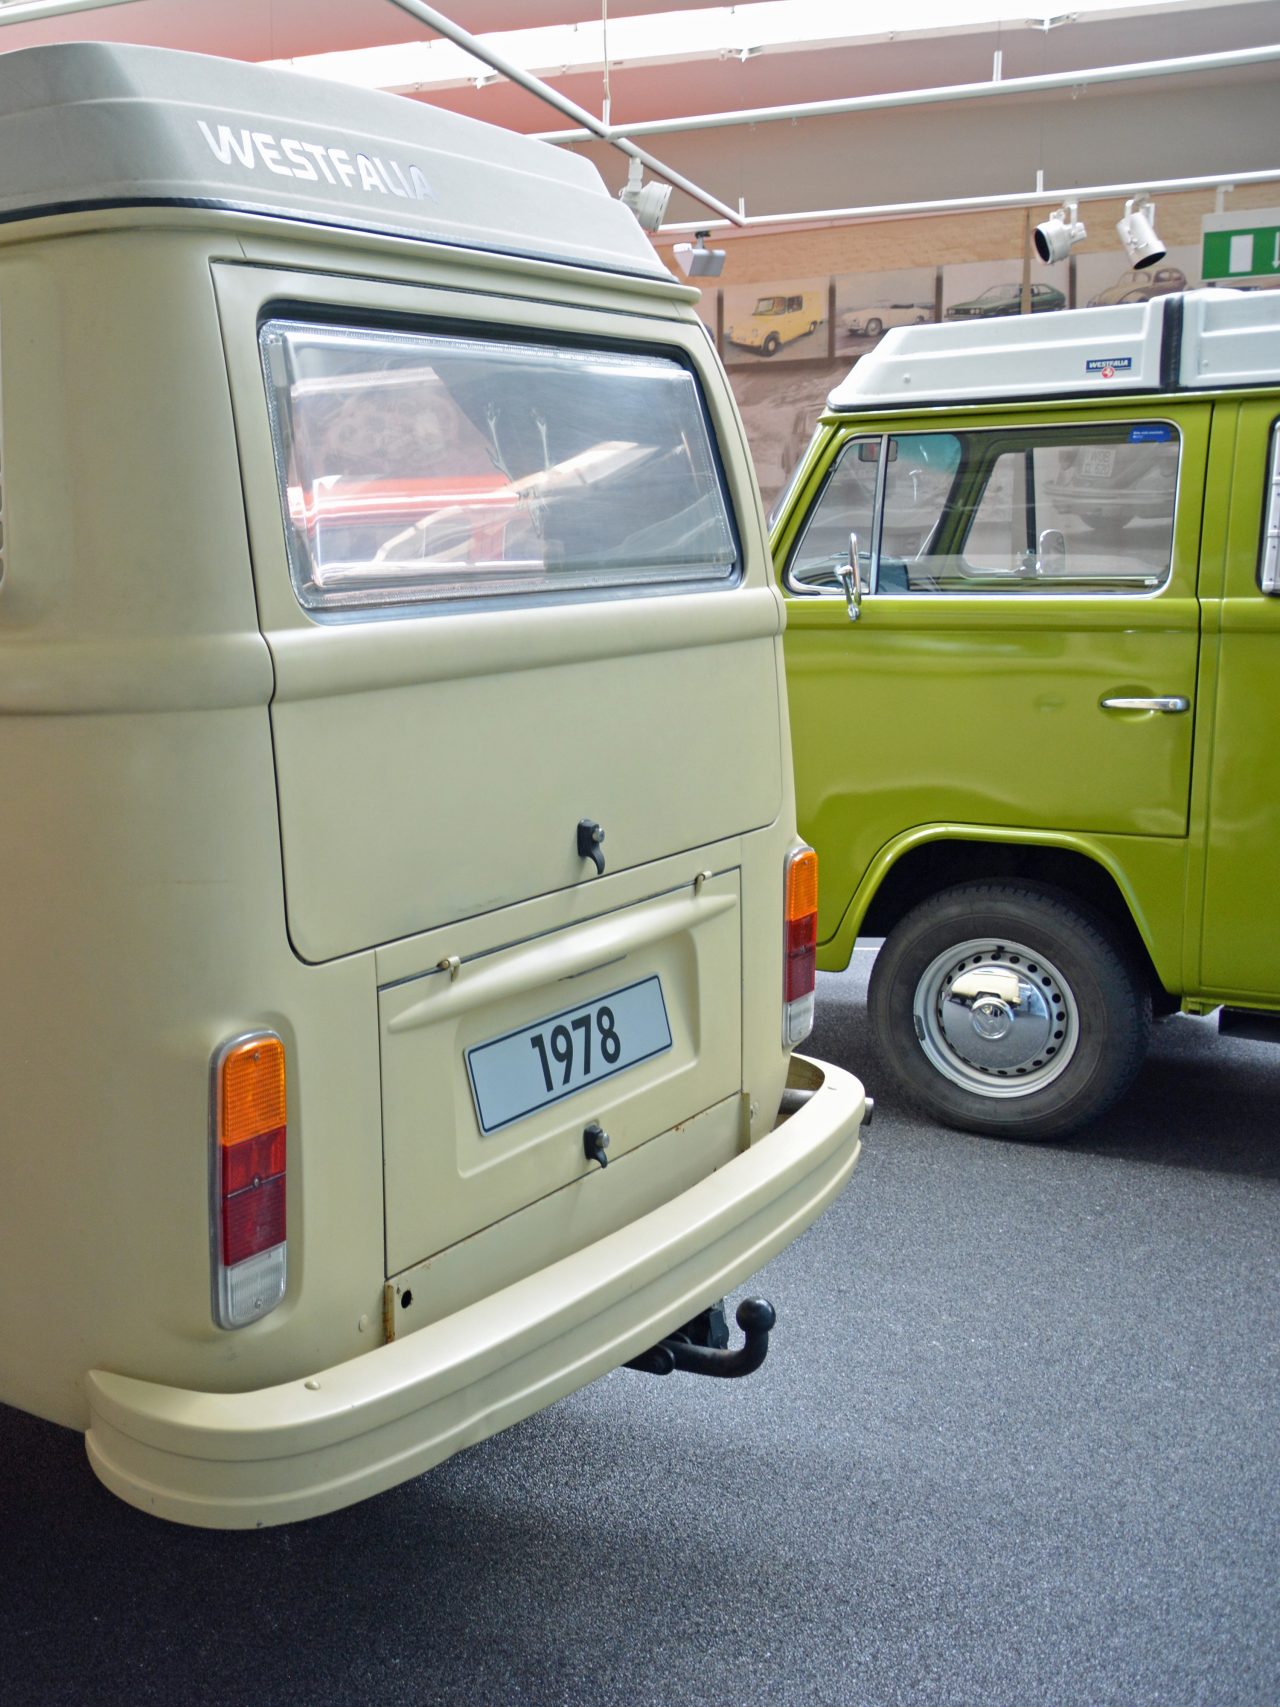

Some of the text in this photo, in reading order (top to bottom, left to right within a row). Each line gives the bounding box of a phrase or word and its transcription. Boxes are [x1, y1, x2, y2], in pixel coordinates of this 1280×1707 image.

[196, 120, 437, 201] WESTFALIA
[1089, 359, 1129, 369] WESTFALIA
[530, 1006, 621, 1093] 1978
